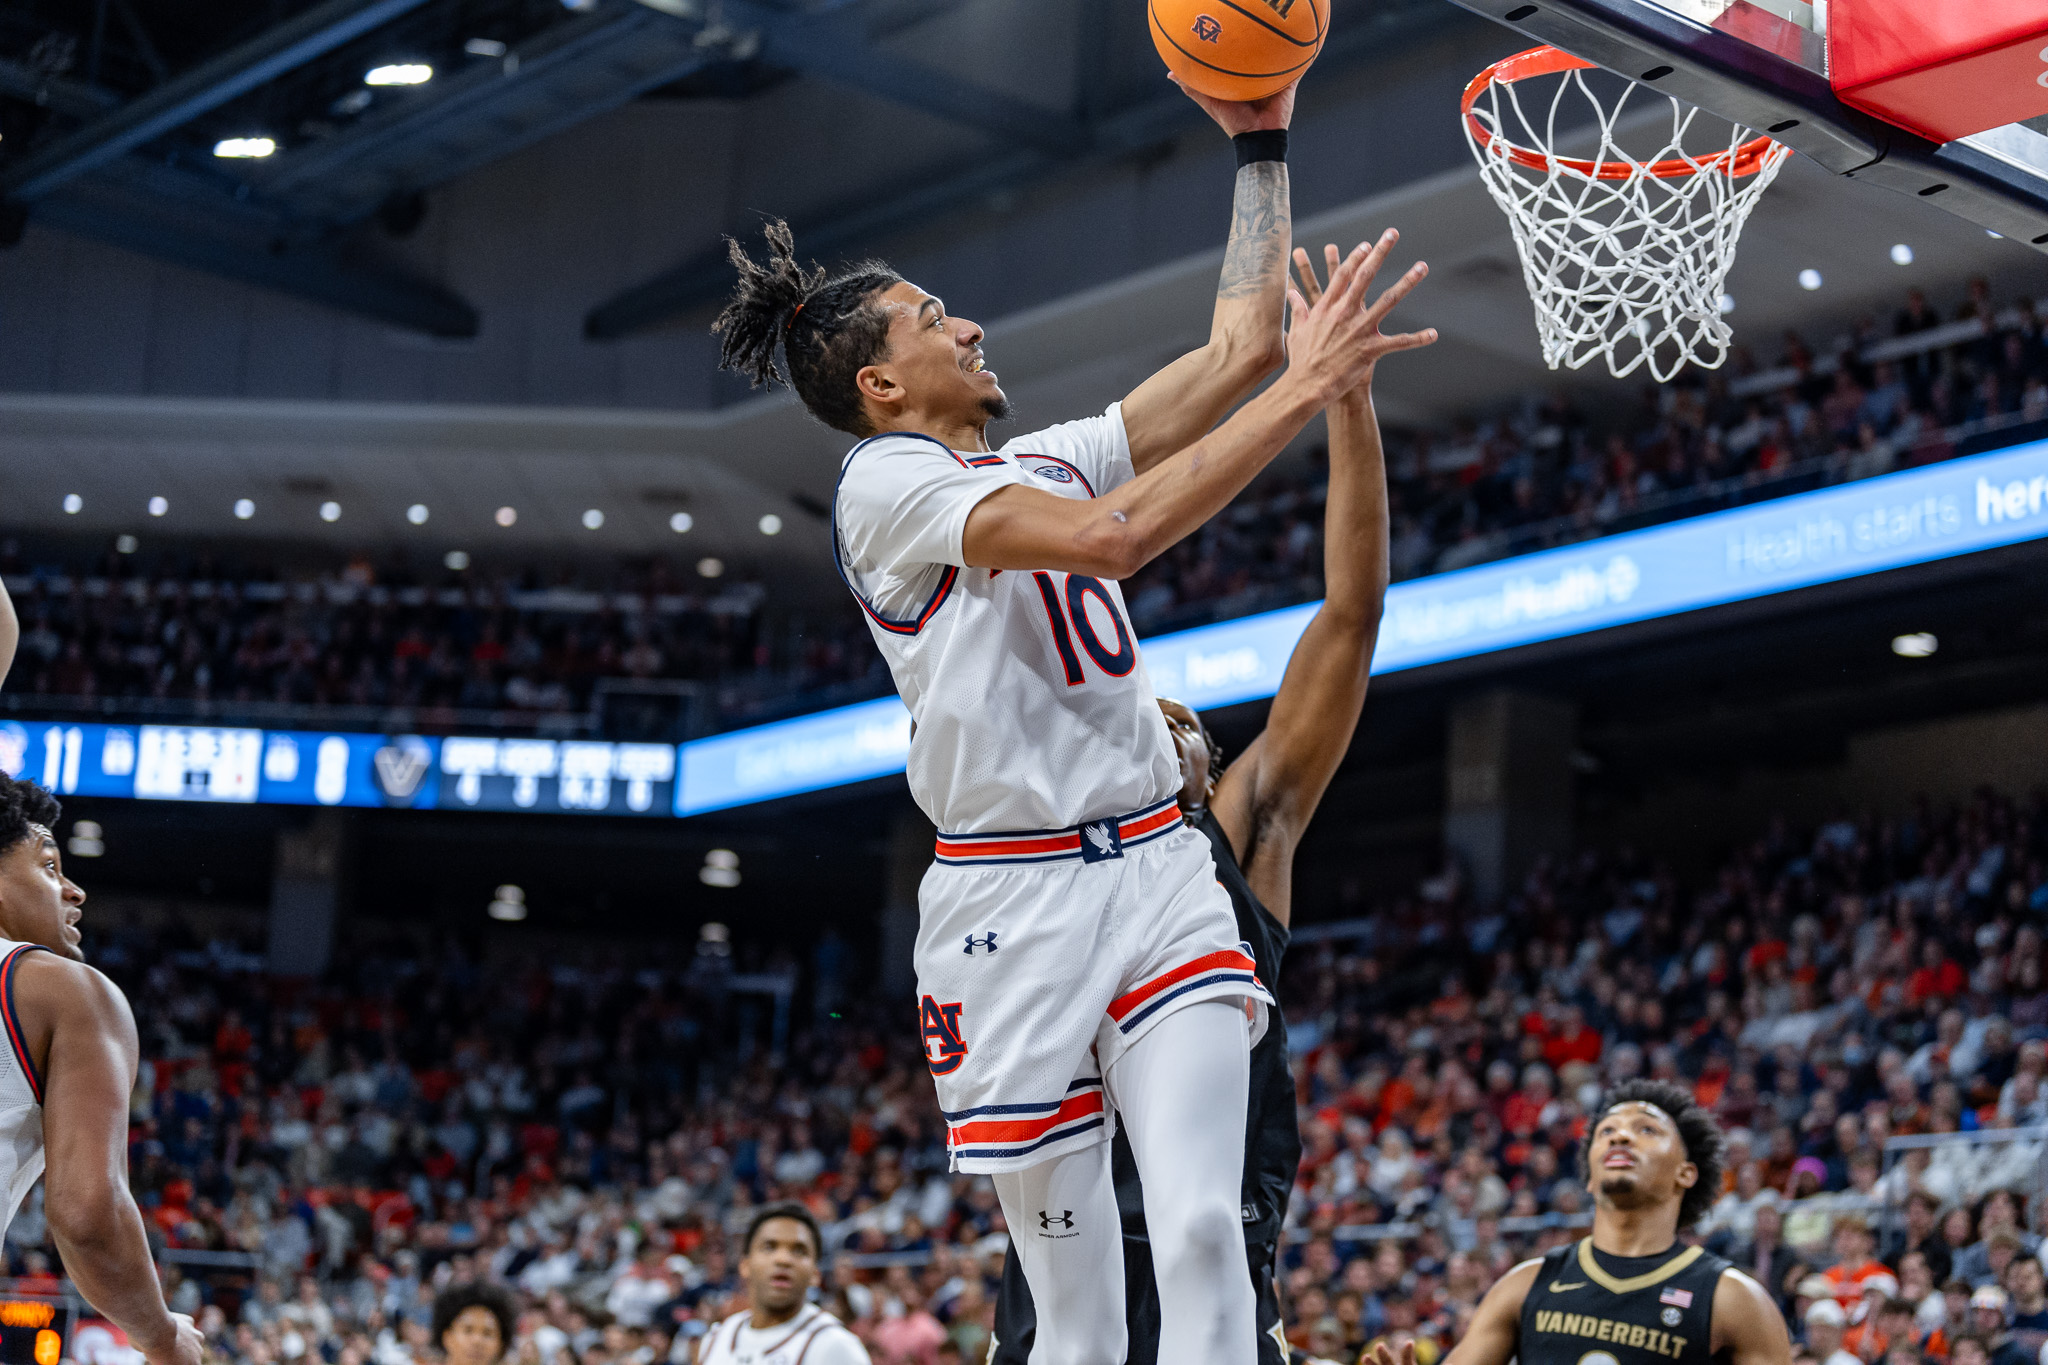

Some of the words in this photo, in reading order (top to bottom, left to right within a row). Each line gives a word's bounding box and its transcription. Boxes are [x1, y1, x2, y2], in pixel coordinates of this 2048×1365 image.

[1976, 474, 2048, 526] her
[1032, 570, 1136, 686] 10
[1055, 1231, 1080, 1239] ARMOUR
[1535, 1310, 1688, 1360] VANDERBILT
